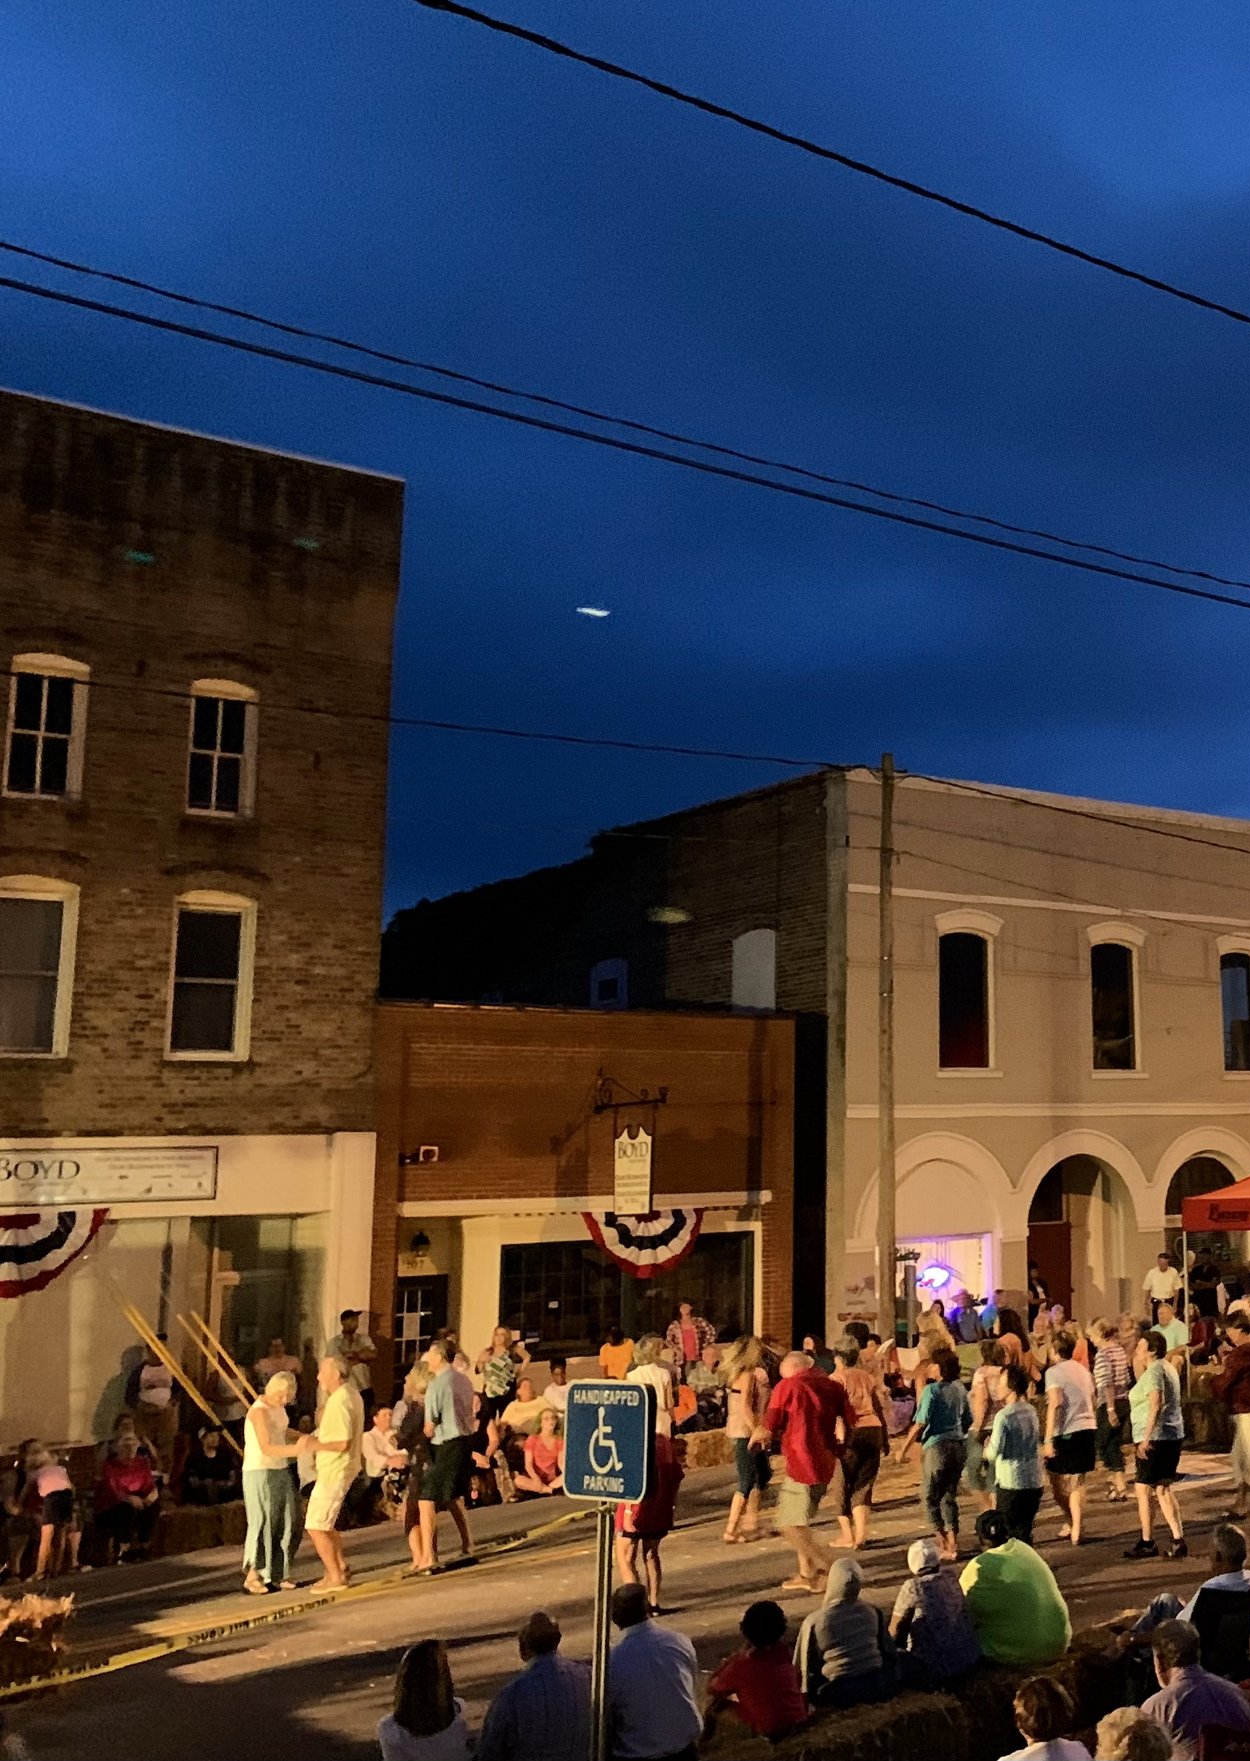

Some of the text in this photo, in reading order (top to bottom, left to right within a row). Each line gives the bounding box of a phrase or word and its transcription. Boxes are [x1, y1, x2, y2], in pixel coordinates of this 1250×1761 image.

[617, 1142, 649, 1159] BOYD
[573, 1390, 640, 1407] HANDICAPPED
[583, 1475, 624, 1493] PARKING
